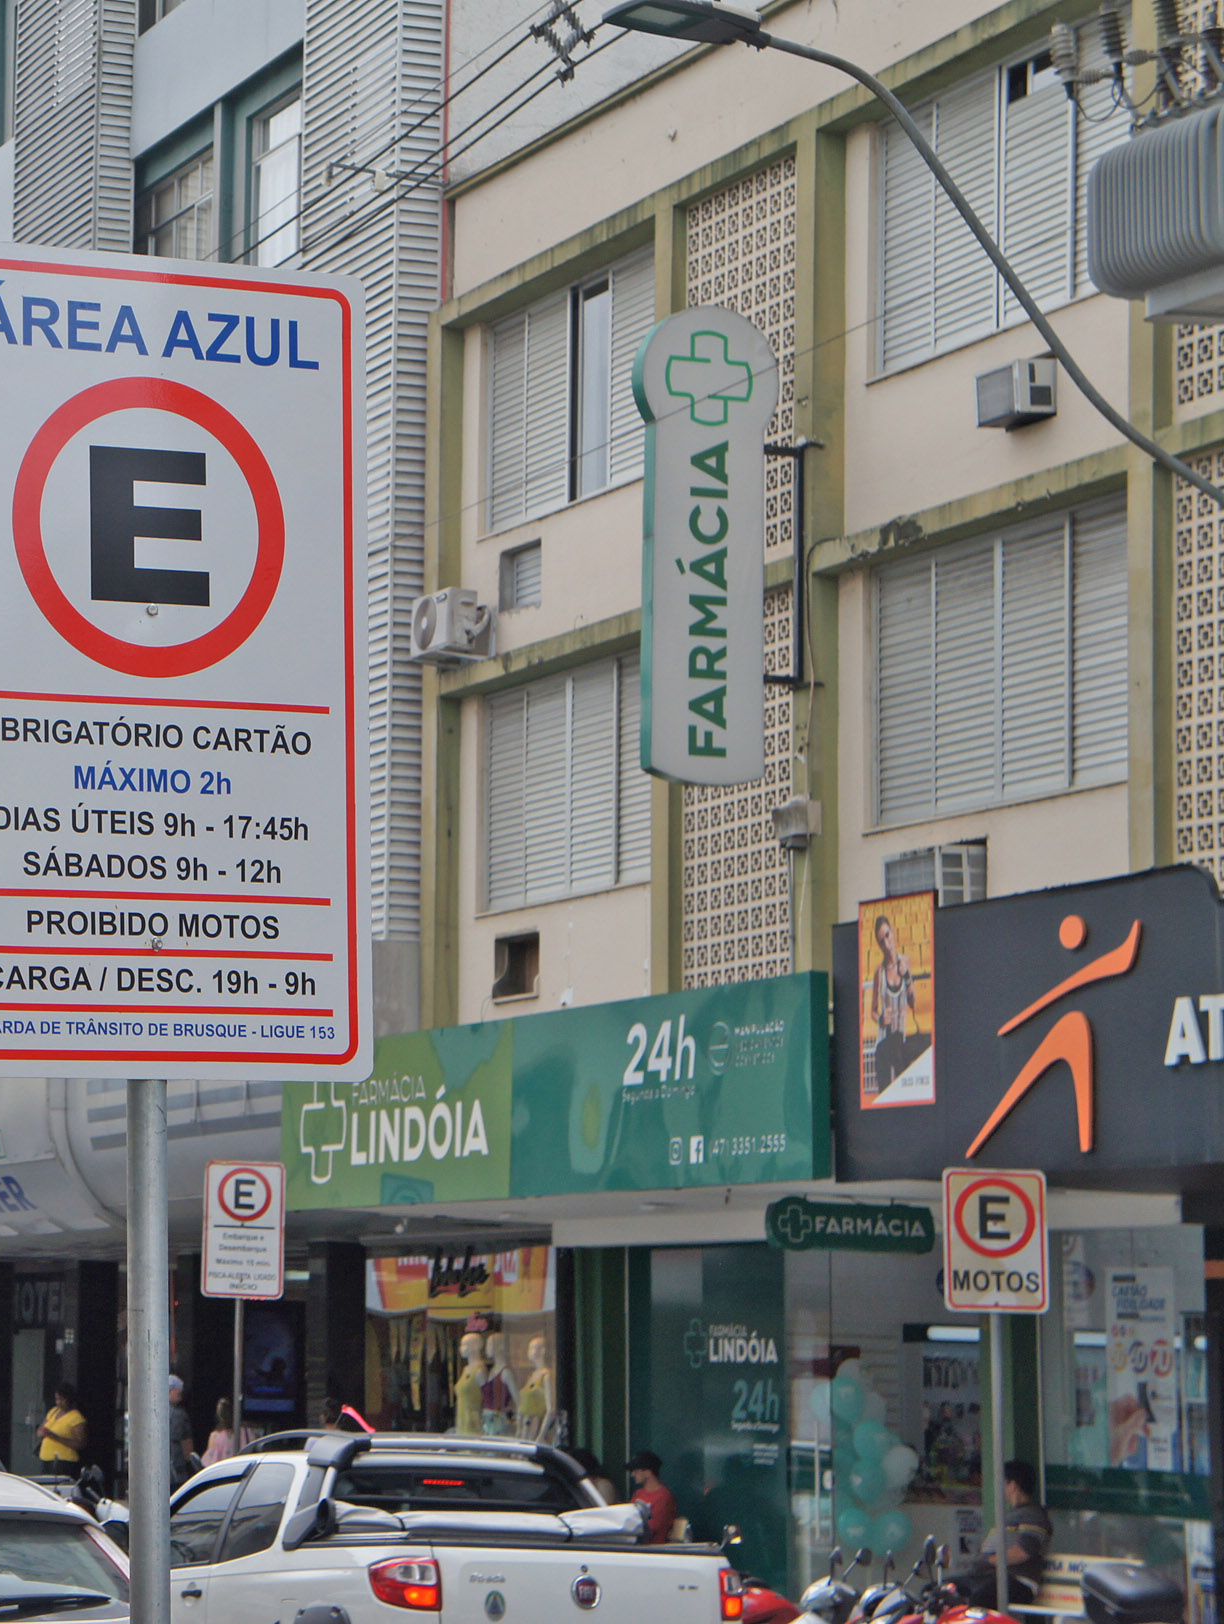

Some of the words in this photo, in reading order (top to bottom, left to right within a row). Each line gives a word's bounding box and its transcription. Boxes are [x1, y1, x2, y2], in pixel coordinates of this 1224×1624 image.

[161, 309, 320, 370] AZUL
[89, 444, 211, 607] E
[675, 440, 729, 758] FARMÁCIA
[192, 725, 313, 756] CARTÃO
[73, 760, 191, 794] MÁXIMO
[200, 770, 233, 795] 2h
[71, 802, 155, 835] ÚTEIS
[163, 813, 196, 837] 9h
[223, 815, 310, 841] 17:45h
[22, 846, 168, 880] SÁBADOS
[175, 856, 209, 882] 9h
[235, 858, 282, 884] 12h
[26, 910, 169, 937] PROIBIDO
[178, 913, 280, 939] MOTOS
[98, 966, 108, 993] /
[116, 967, 203, 994] DESC.
[212, 969, 259, 995] 19h
[284, 971, 317, 996] 9h
[40, 1021, 62, 1035] DE
[65, 1018, 144, 1036] TRÂNSITO
[148, 1022, 169, 1037] DE
[172, 1023, 248, 1039] BRUSQUE
[260, 1024, 306, 1040] LIGUE
[309, 1025, 336, 1040] 153
[1164, 993, 1224, 1067] AT
[623, 1013, 696, 1086] 24h
[350, 1074, 427, 1107] FARMÁCIA
[349, 1084, 489, 1167] LINDÓIA
[234, 1178, 256, 1211] E
[814, 1213, 926, 1238] FARMÁCIA
[979, 1195, 1011, 1241] E
[952, 1269, 1040, 1293] MOTOS
[709, 1330, 779, 1364] LINDÓIA
[732, 1378, 780, 1421] 24h
